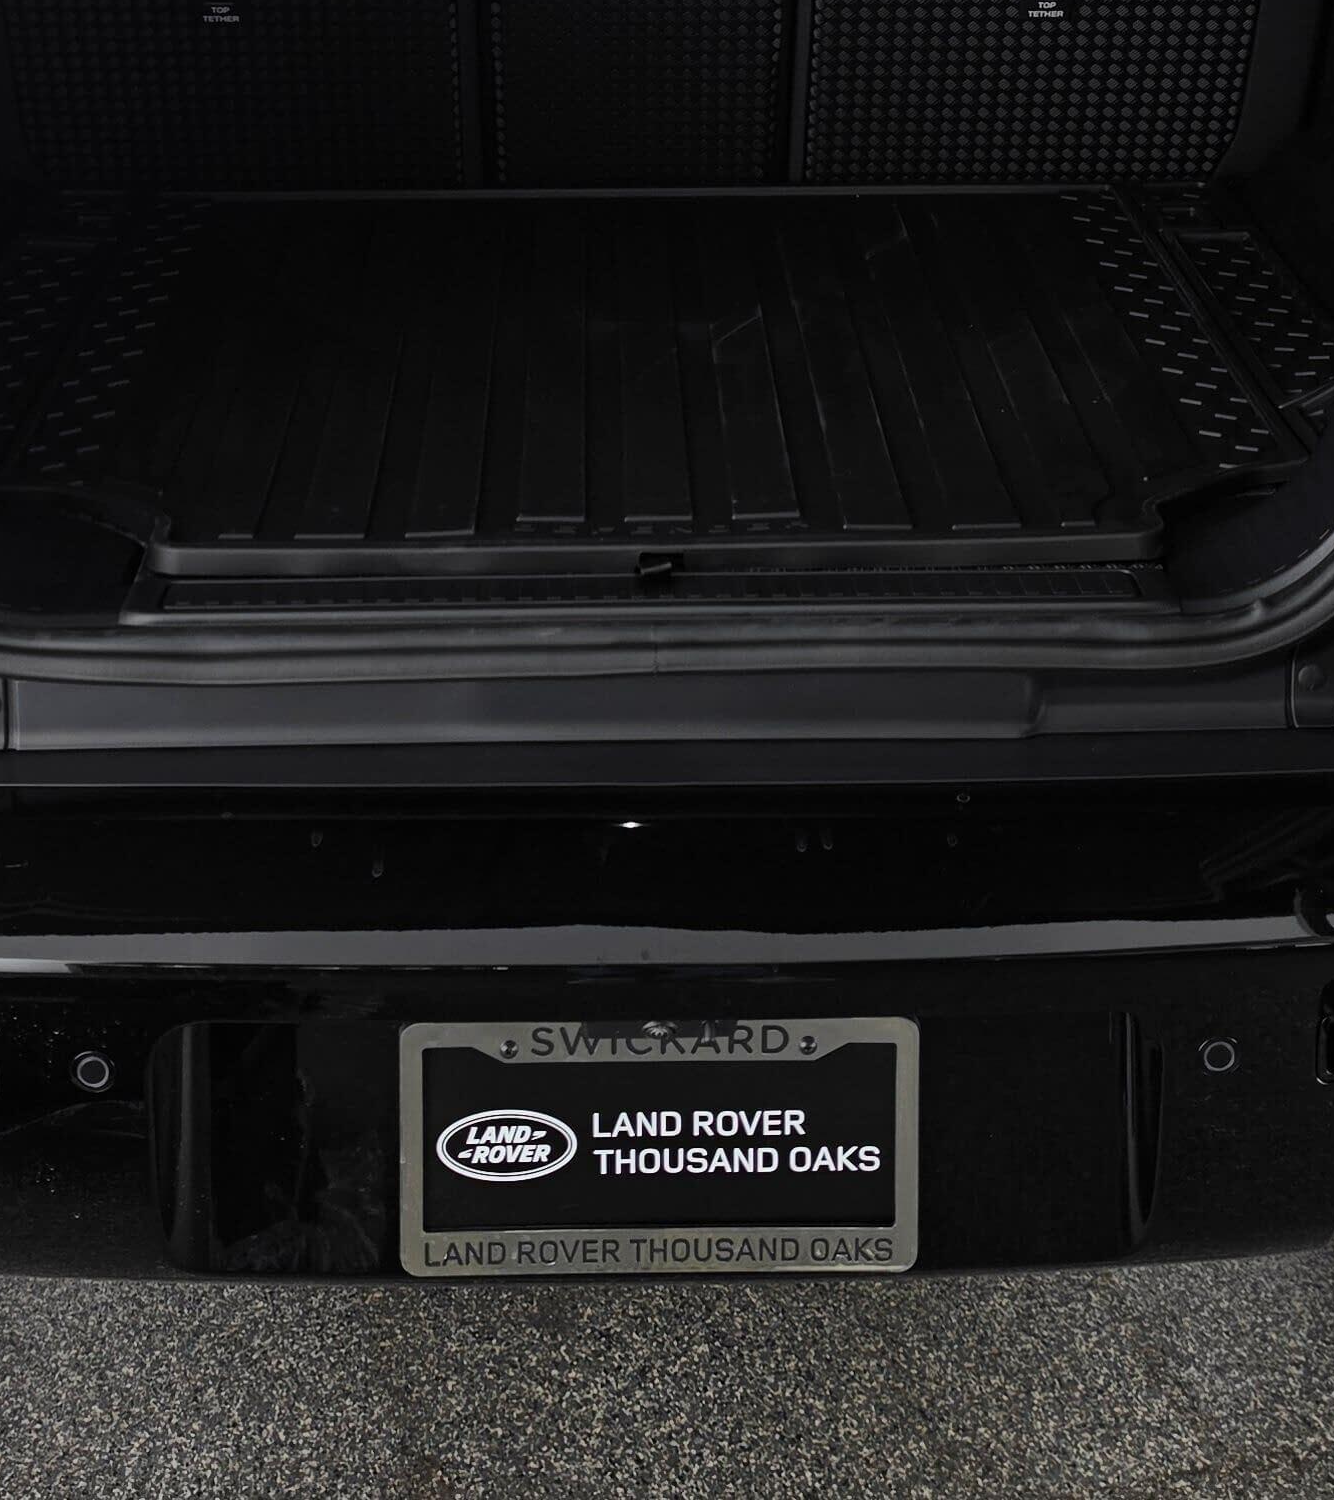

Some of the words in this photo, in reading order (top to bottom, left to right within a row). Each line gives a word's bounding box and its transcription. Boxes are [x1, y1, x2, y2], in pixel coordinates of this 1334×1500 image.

[211, 6, 230, 14] TOP
[1027, 10, 1064, 18] TETHER
[1038, 1, 1057, 9] TOP
[203, 15, 240, 23] TETHER
[592, 1110, 681, 1138] LAND
[692, 1109, 806, 1137] ROVER
[466, 1125, 532, 1145] LAND
[470, 1144, 551, 1164] ROVER
[594, 1147, 778, 1175] THOUSAND
[789, 1145, 881, 1173] OAKS
[423, 1241, 506, 1267] LAND
[517, 1239, 621, 1266] ROVER
[629, 1237, 800, 1264] THOUSAND
[809, 1237, 893, 1263] OAKS
